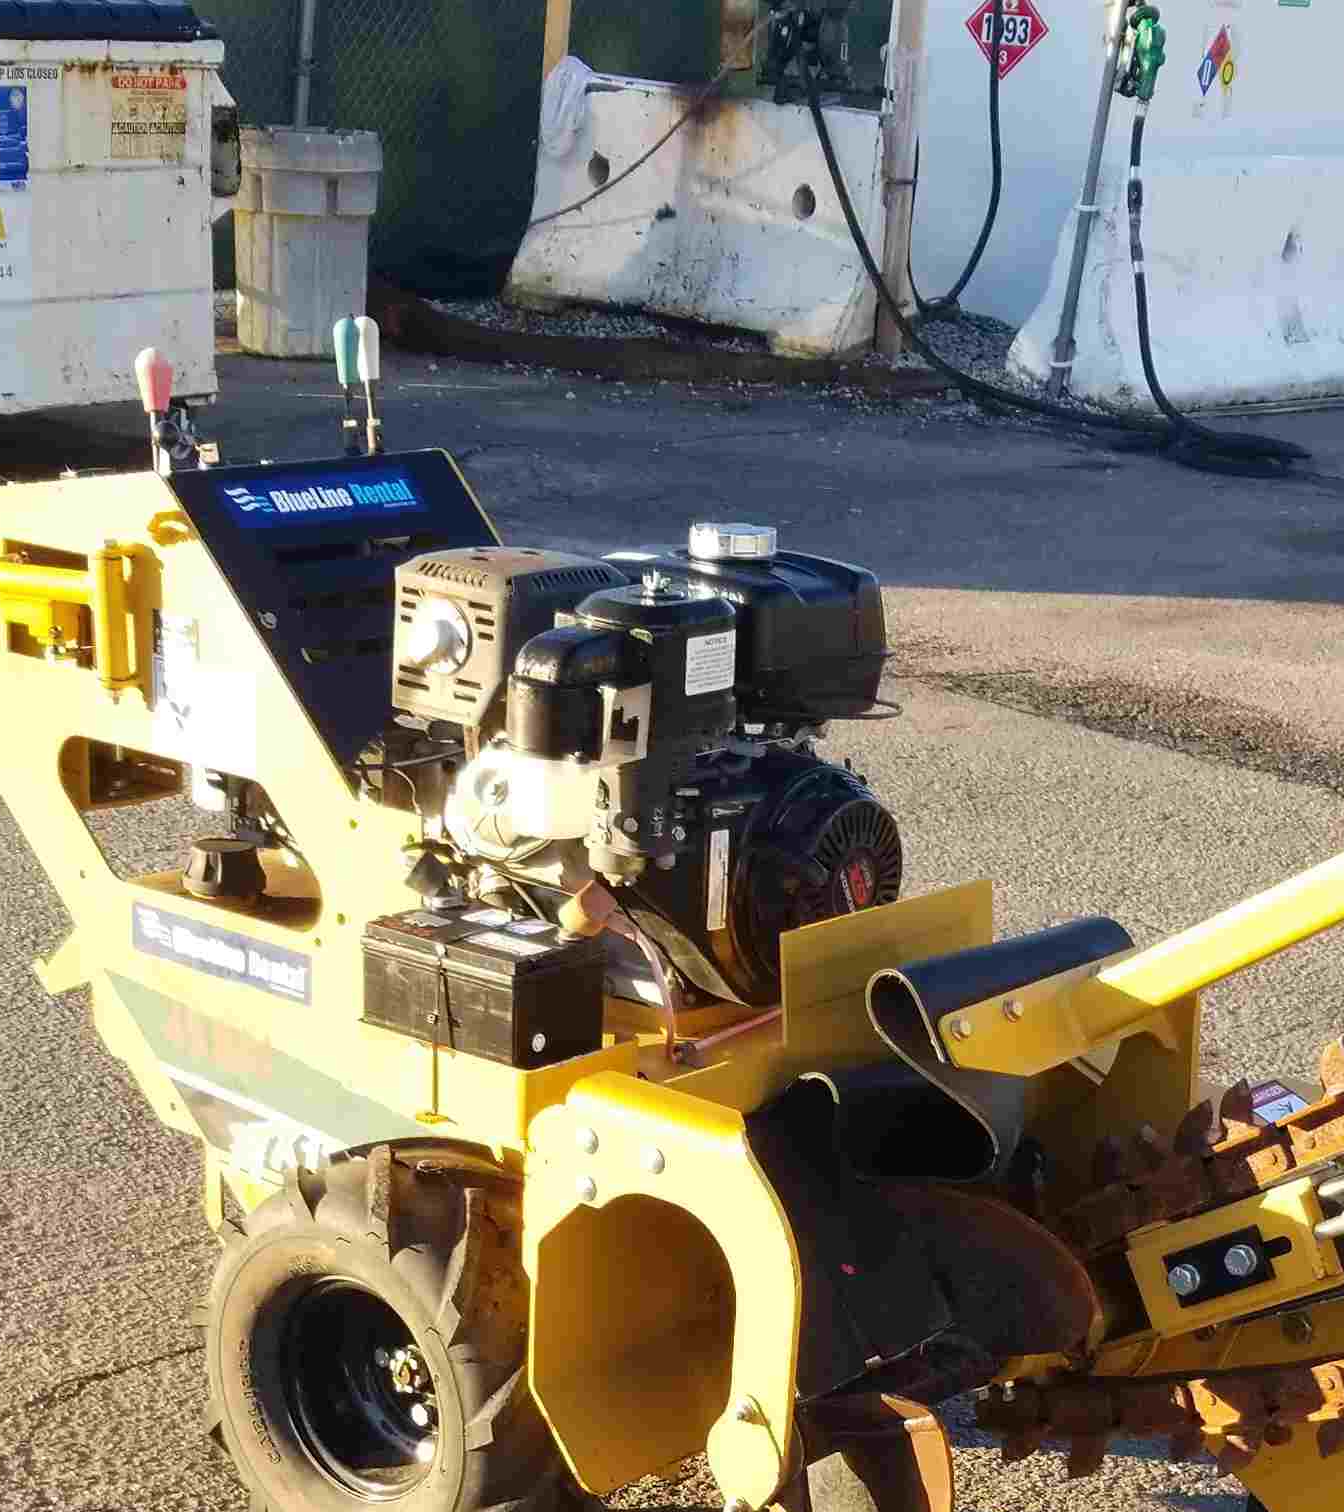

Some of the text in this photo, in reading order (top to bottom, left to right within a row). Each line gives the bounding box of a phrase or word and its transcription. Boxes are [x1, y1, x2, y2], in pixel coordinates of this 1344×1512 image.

[984, 15, 1030, 44] 193
[999, 50, 1008, 64] 3
[270, 479, 414, 512] BlueLine Rental
